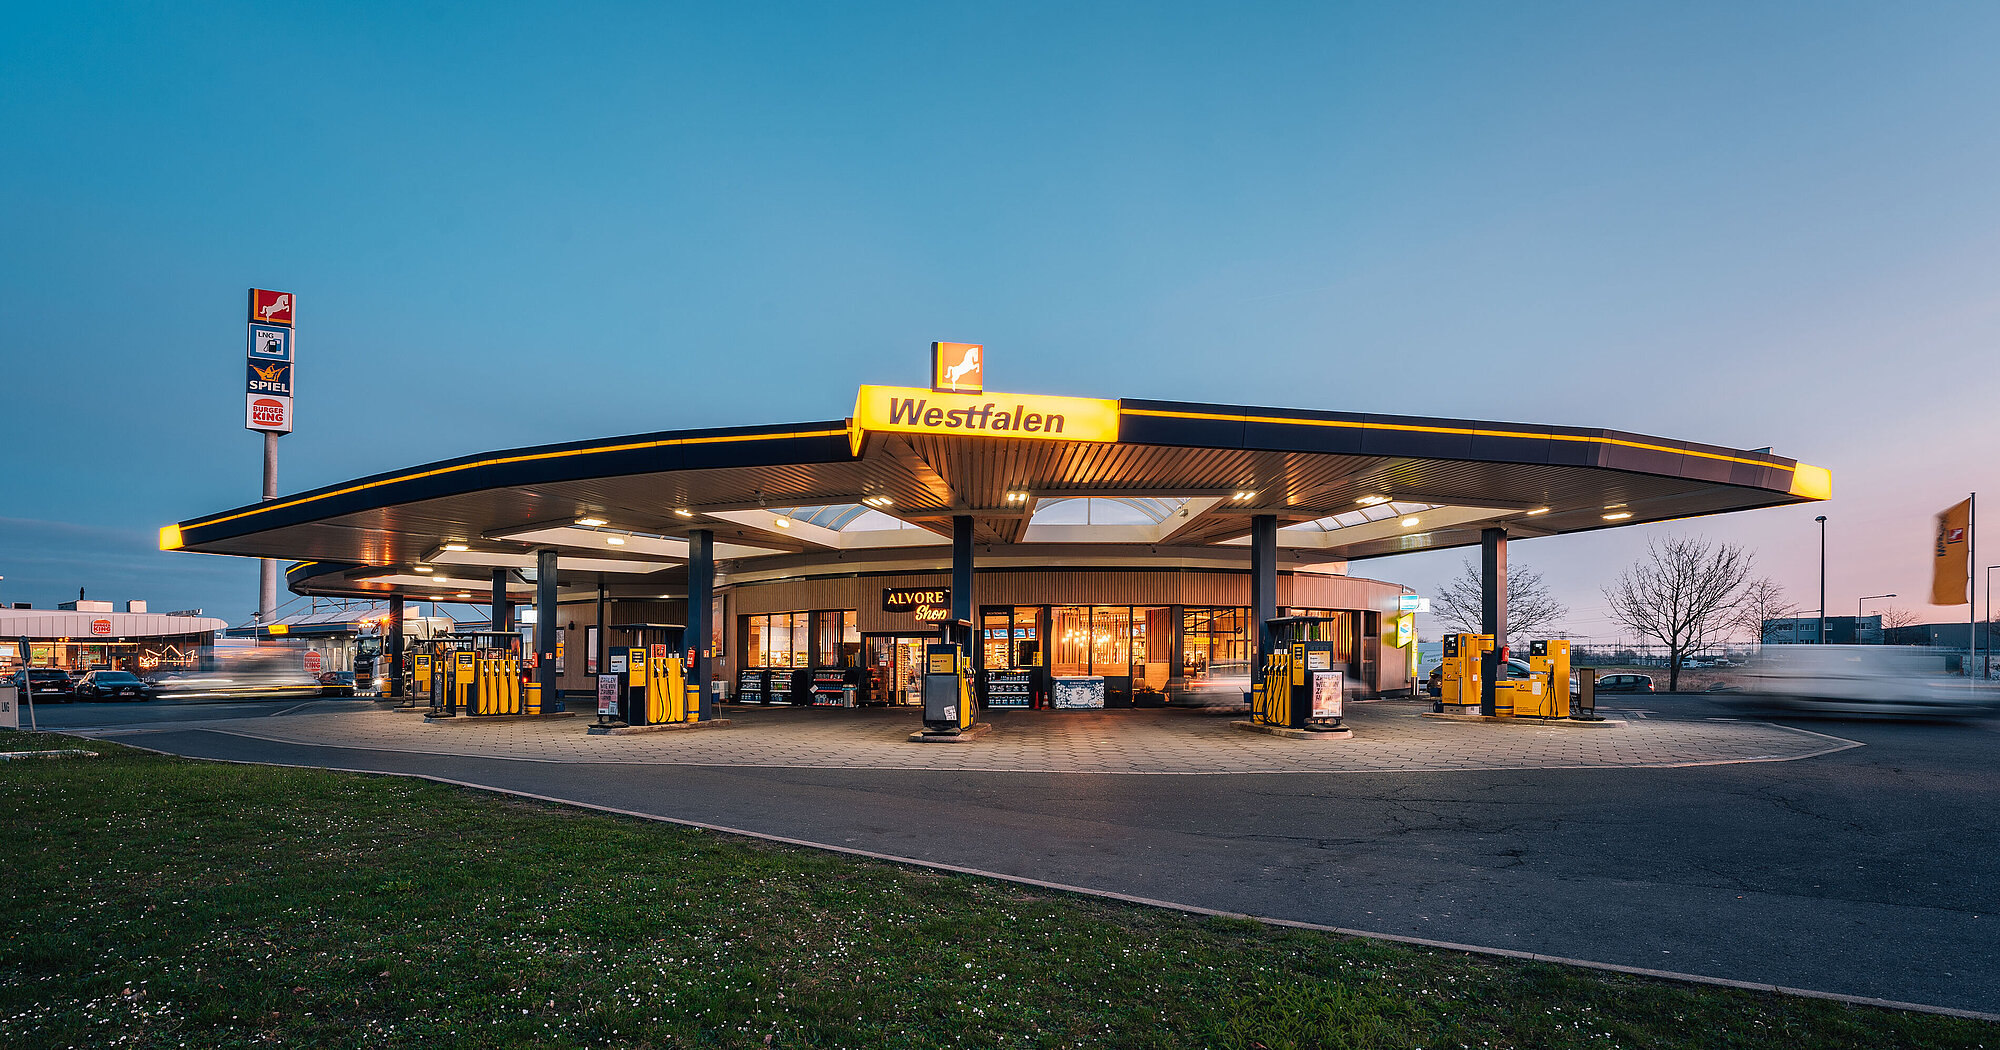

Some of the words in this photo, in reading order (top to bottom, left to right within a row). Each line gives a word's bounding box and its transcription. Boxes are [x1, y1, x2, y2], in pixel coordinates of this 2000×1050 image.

[258, 331, 274, 339] LNG
[249, 380, 290, 393] SPIEL
[253, 405, 284, 414] BURGER
[889, 397, 1065, 433] Westfalen
[253, 411, 284, 422] KING
[887, 591, 945, 605] ALVORE
[1, 701, 10, 713] LNG
